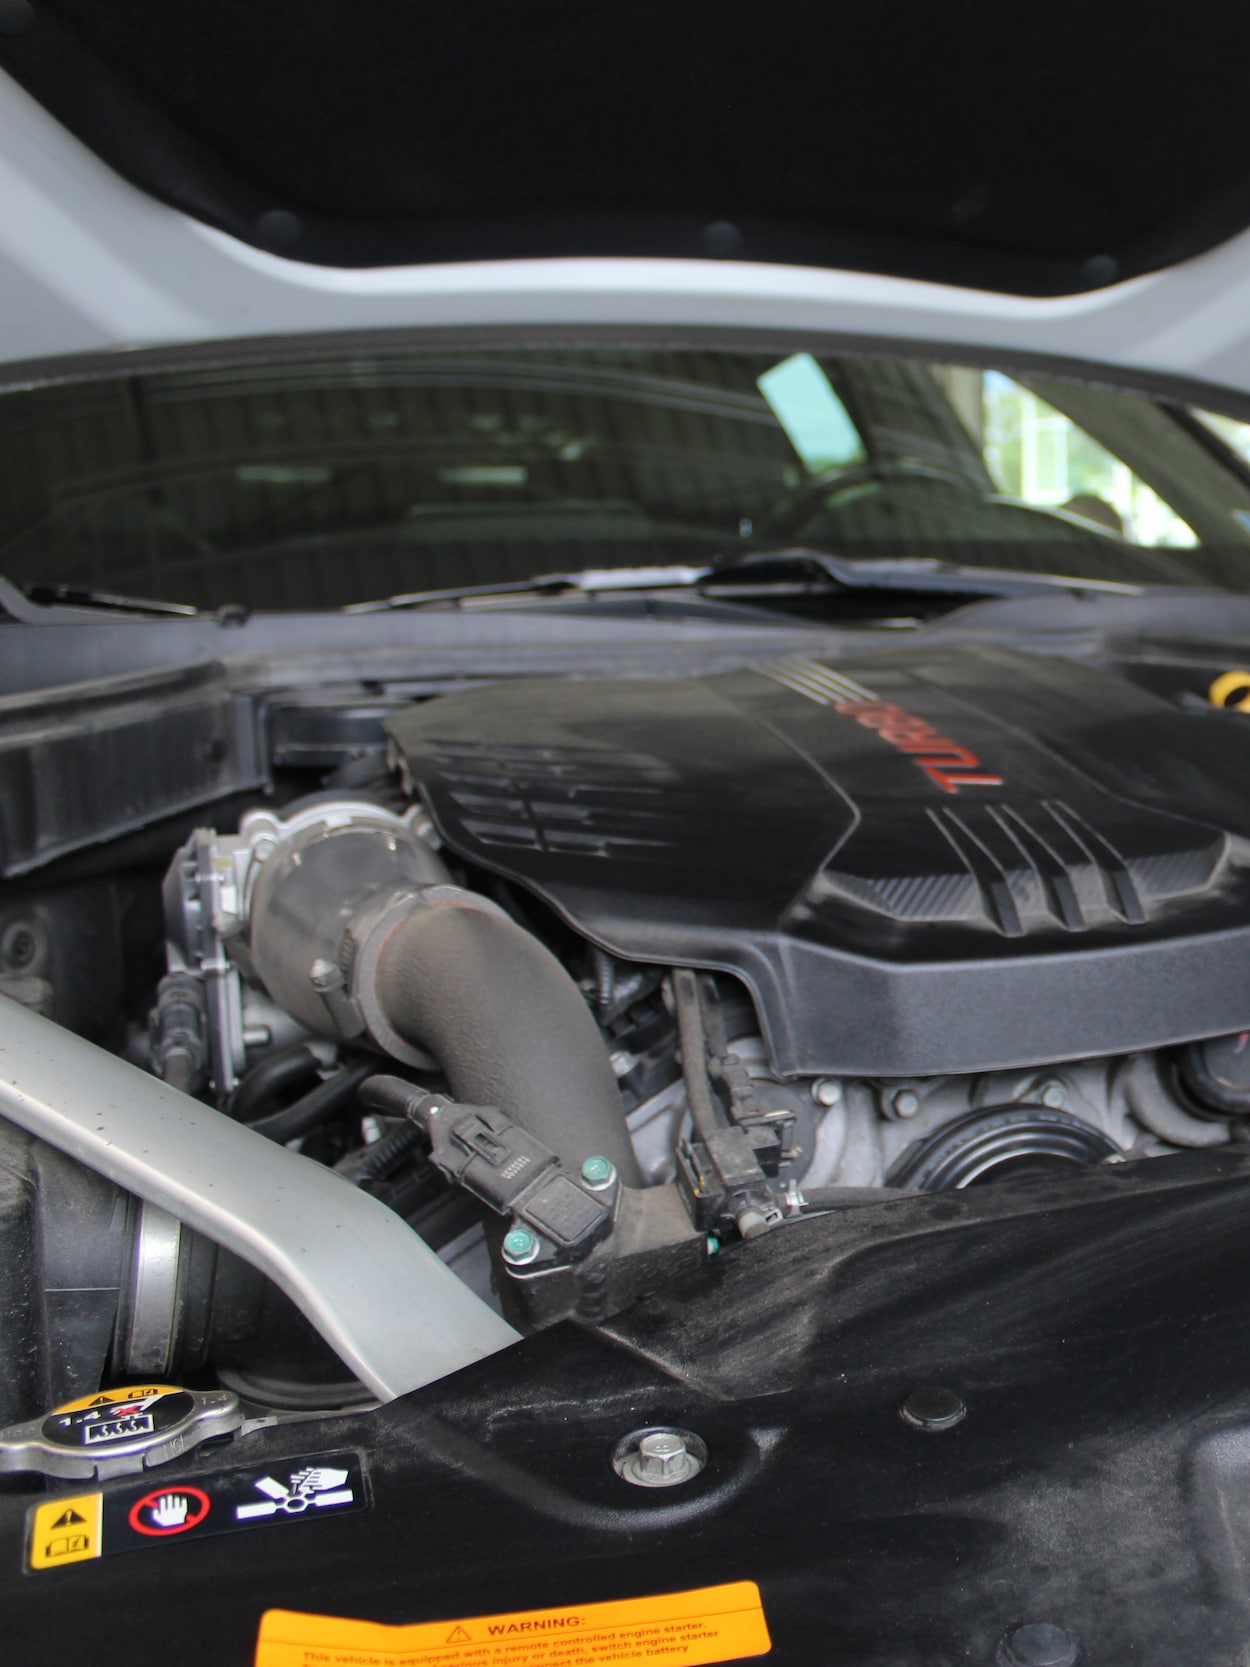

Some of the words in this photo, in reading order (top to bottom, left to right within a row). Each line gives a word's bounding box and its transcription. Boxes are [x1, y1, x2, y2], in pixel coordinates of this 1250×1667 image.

[59, 1410, 101, 1426] 1.4
[488, 1616, 586, 1635] WARNING:
[303, 1651, 330, 1662] This
[335, 1655, 380, 1665] vehicle
[383, 1657, 395, 1665] is
[400, 1651, 460, 1667] equipped
[463, 1648, 491, 1658] with
[505, 1641, 549, 1653] remote
[553, 1633, 616, 1647] controlled
[619, 1628, 660, 1639] engine
[664, 1623, 707, 1633] starter.
[492, 1655, 529, 1665] injury
[532, 1653, 545, 1661] or
[591, 1640, 632, 1653] switch
[635, 1636, 676, 1647] engine
[680, 1630, 719, 1641] starter
[575, 1657, 595, 1666] the
[599, 1650, 642, 1662] vehicle
[646, 1645, 688, 1657] battery
